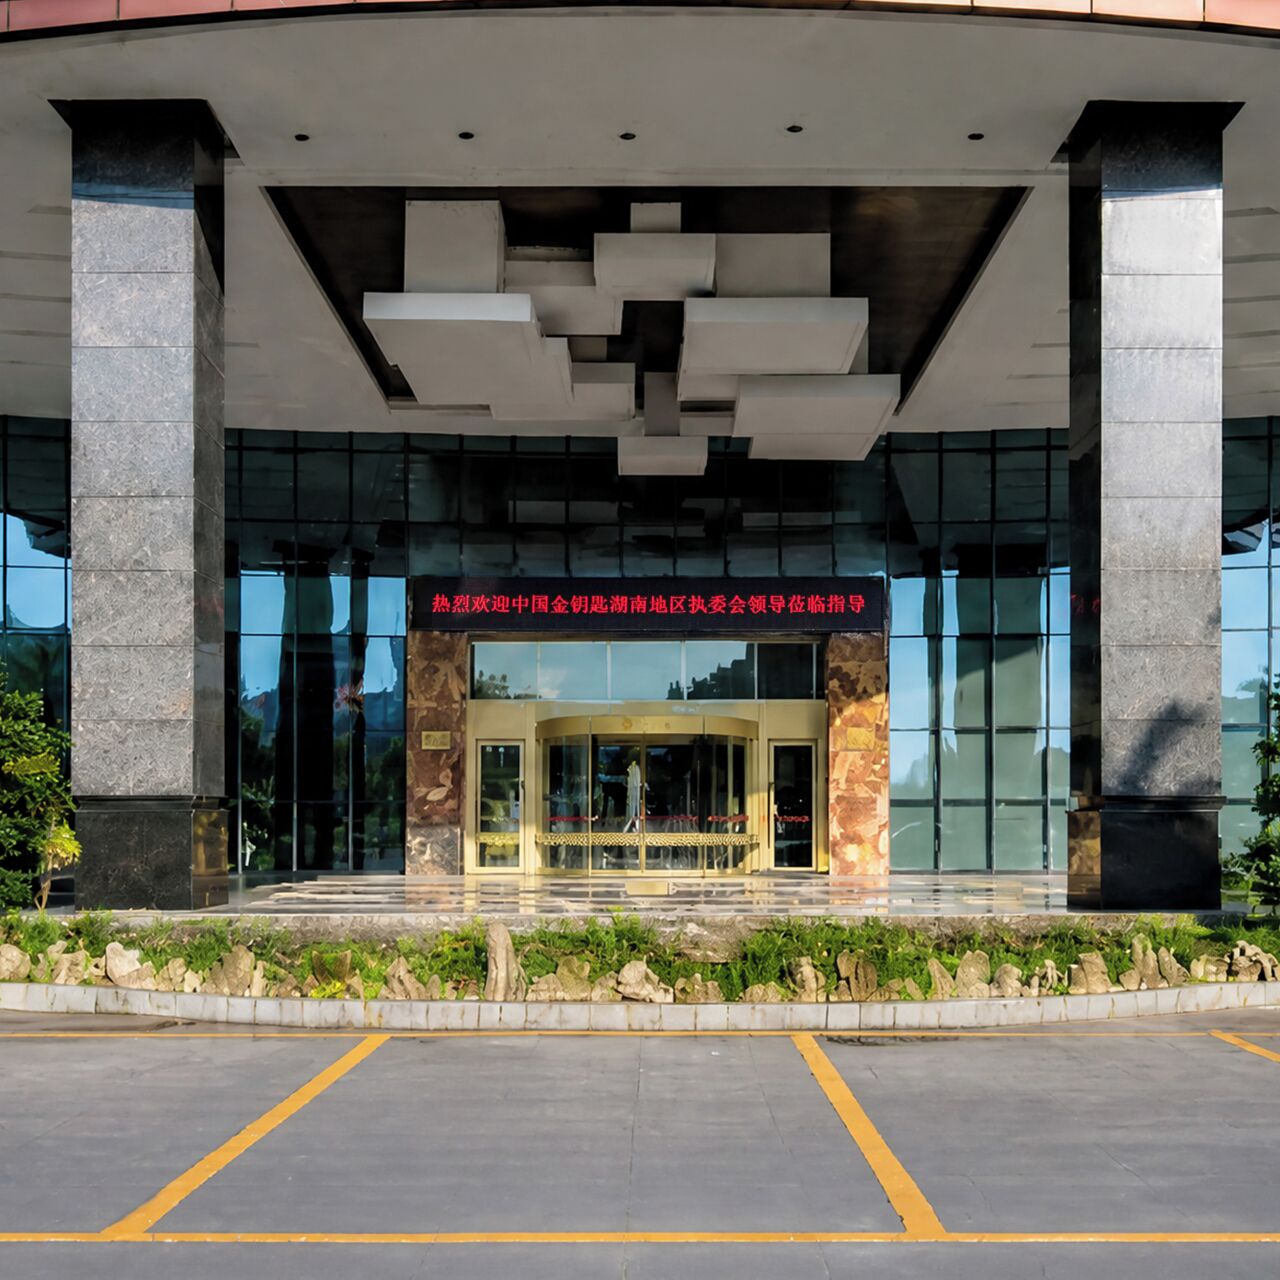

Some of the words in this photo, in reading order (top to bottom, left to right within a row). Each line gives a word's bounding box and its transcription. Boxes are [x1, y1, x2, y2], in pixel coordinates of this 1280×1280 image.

[431, 593, 866, 615] 热烈欢迎中国金钥匙湖南地区执委会领导莅临指导
